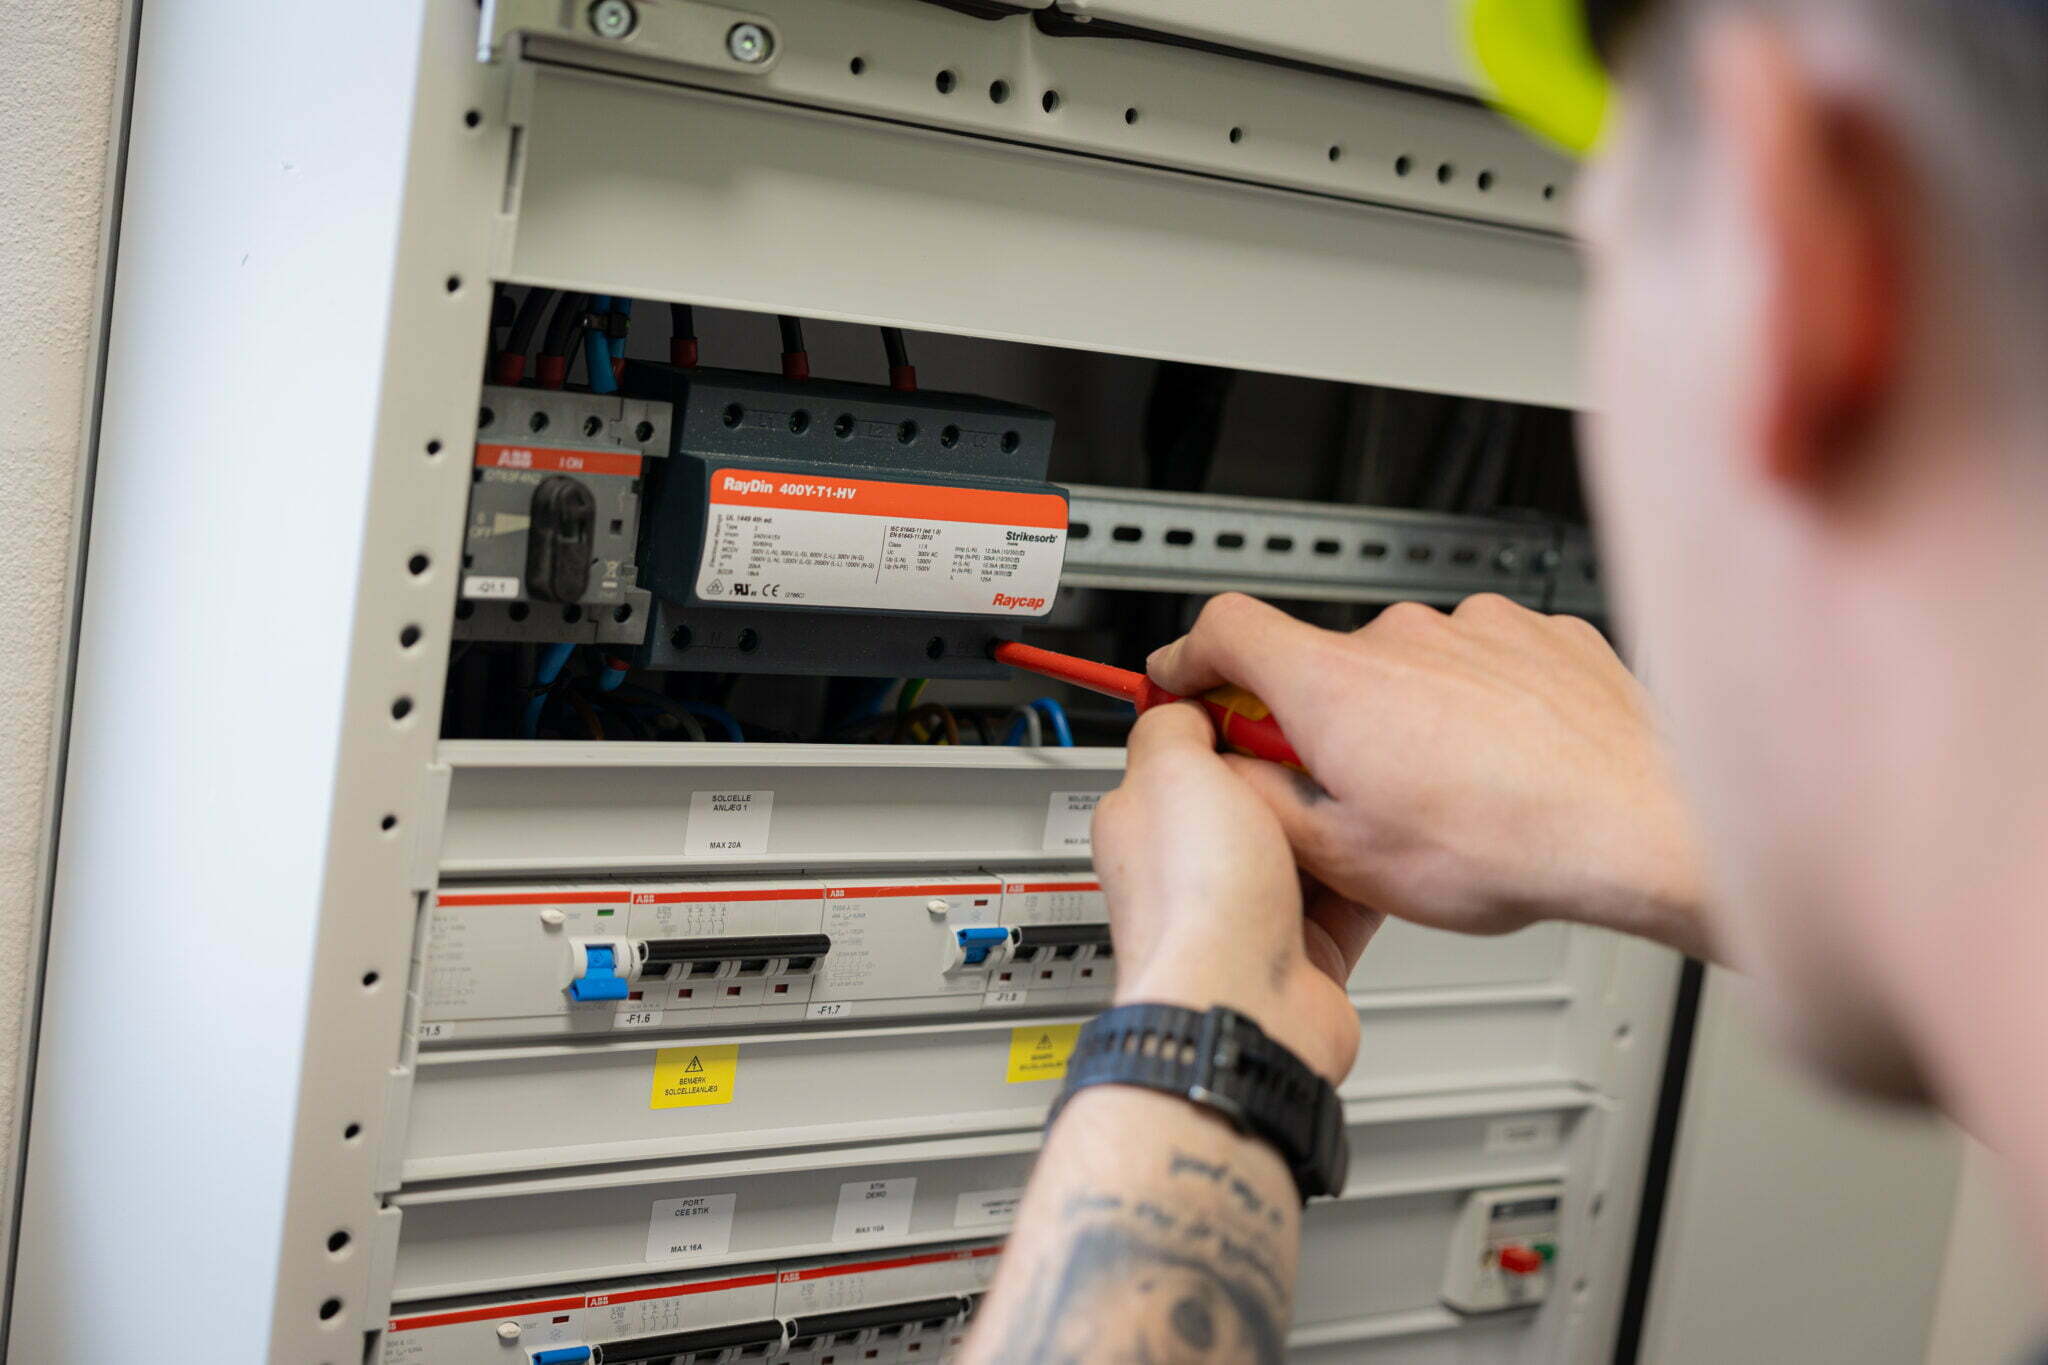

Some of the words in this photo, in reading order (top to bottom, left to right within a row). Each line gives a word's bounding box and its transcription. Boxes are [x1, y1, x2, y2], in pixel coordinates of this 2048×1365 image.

[497, 449, 533, 468] ABB
[566, 457, 584, 469] ON
[724, 477, 773, 494] RayDin
[992, 593, 1045, 610] Raycap
[712, 794, 752, 802] SOLCELLE
[713, 803, 742, 812] ANLÆG
[709, 841, 726, 849] MAX
[727, 841, 742, 849] 20A
[830, 889, 845, 897] ABB
[636, 894, 655, 904] ABB
[817, 1005, 841, 1015] -F1.7
[626, 1014, 651, 1025] -F1.6
[679, 1077, 706, 1086] BEMÆRK
[664, 1086, 718, 1096] SOLCELLEANLÆG
[682, 1199, 705, 1207] PORT
[675, 1209, 690, 1217] CEE
[692, 1207, 710, 1215] STIK
[670, 1245, 687, 1254] MAX
[782, 1271, 800, 1282] ABB
[590, 1296, 608, 1306] ABB
